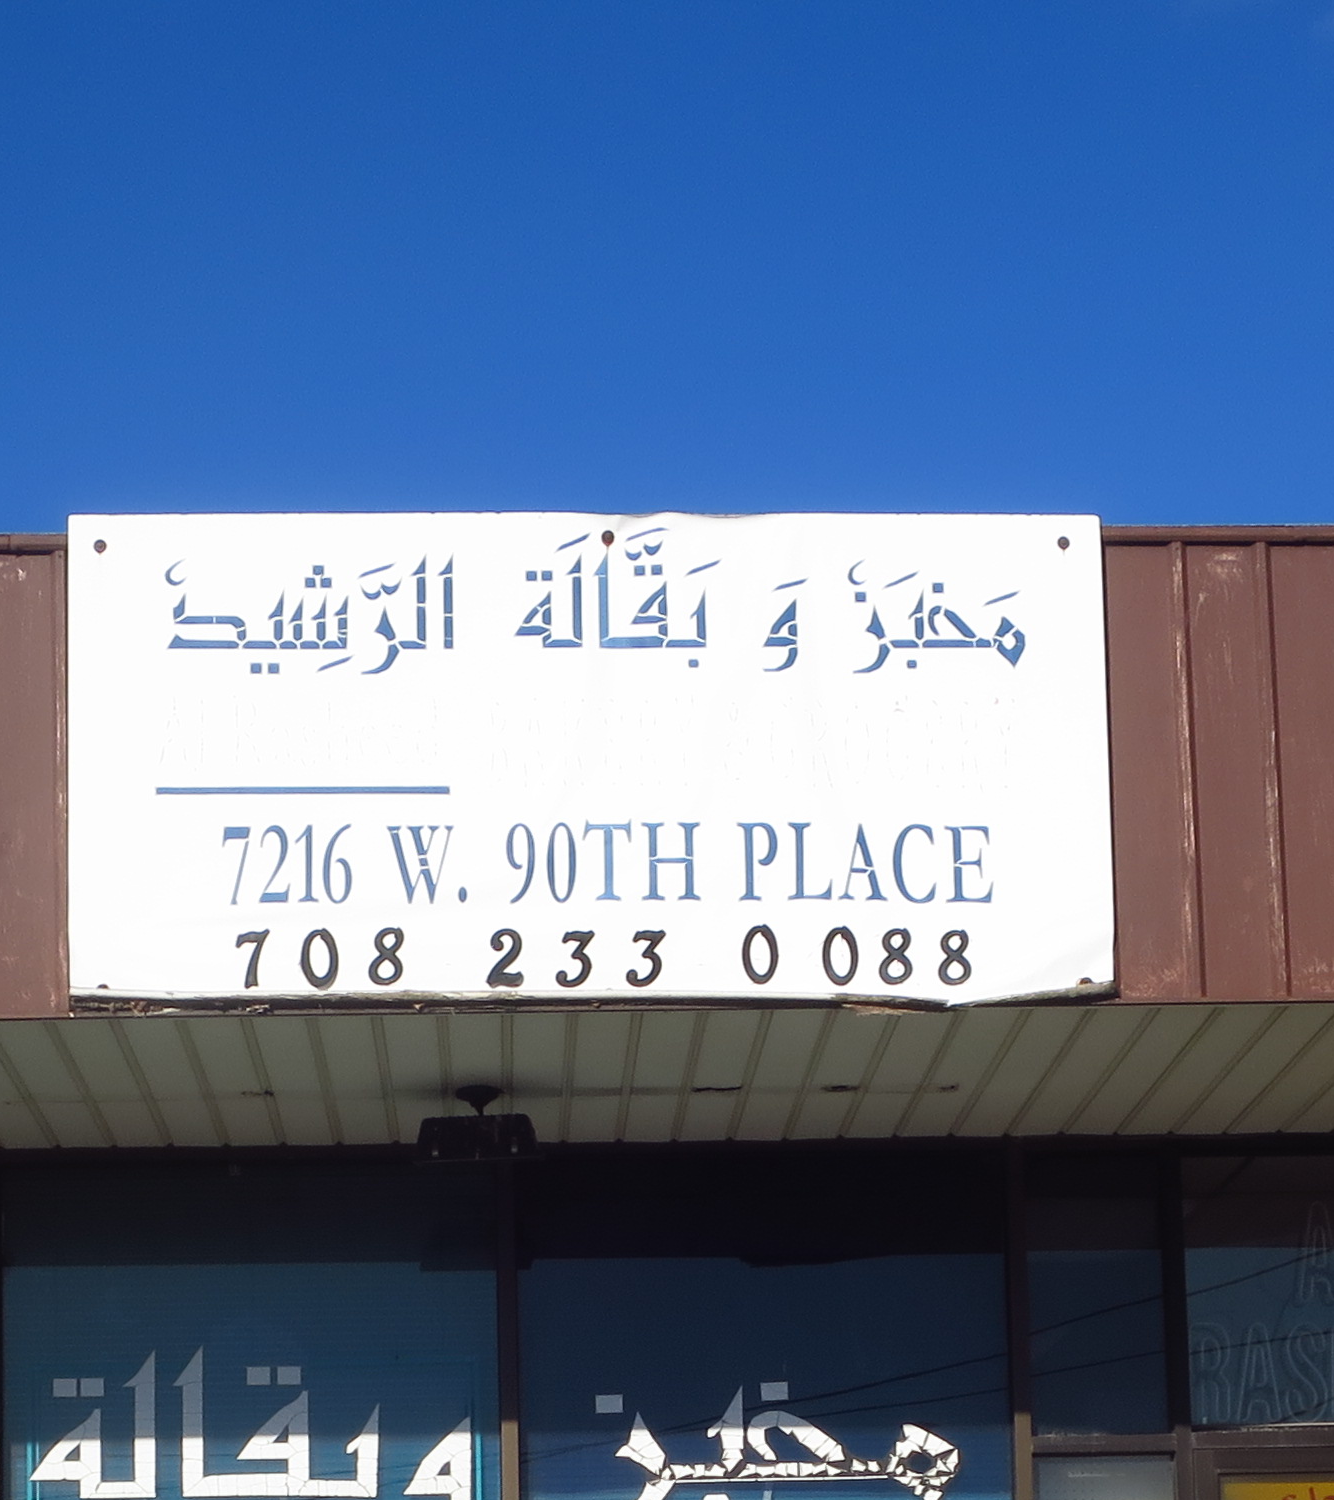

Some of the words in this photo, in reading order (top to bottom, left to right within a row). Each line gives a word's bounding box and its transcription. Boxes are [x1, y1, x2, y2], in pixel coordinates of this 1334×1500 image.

[221, 823, 354, 906] 7216
[390, 823, 468, 904] W.
[506, 820, 702, 902] 90TH
[737, 821, 995, 903] PLACE
[234, 926, 405, 988] 708
[487, 926, 665, 988] 233
[741, 924, 973, 986] 0088
